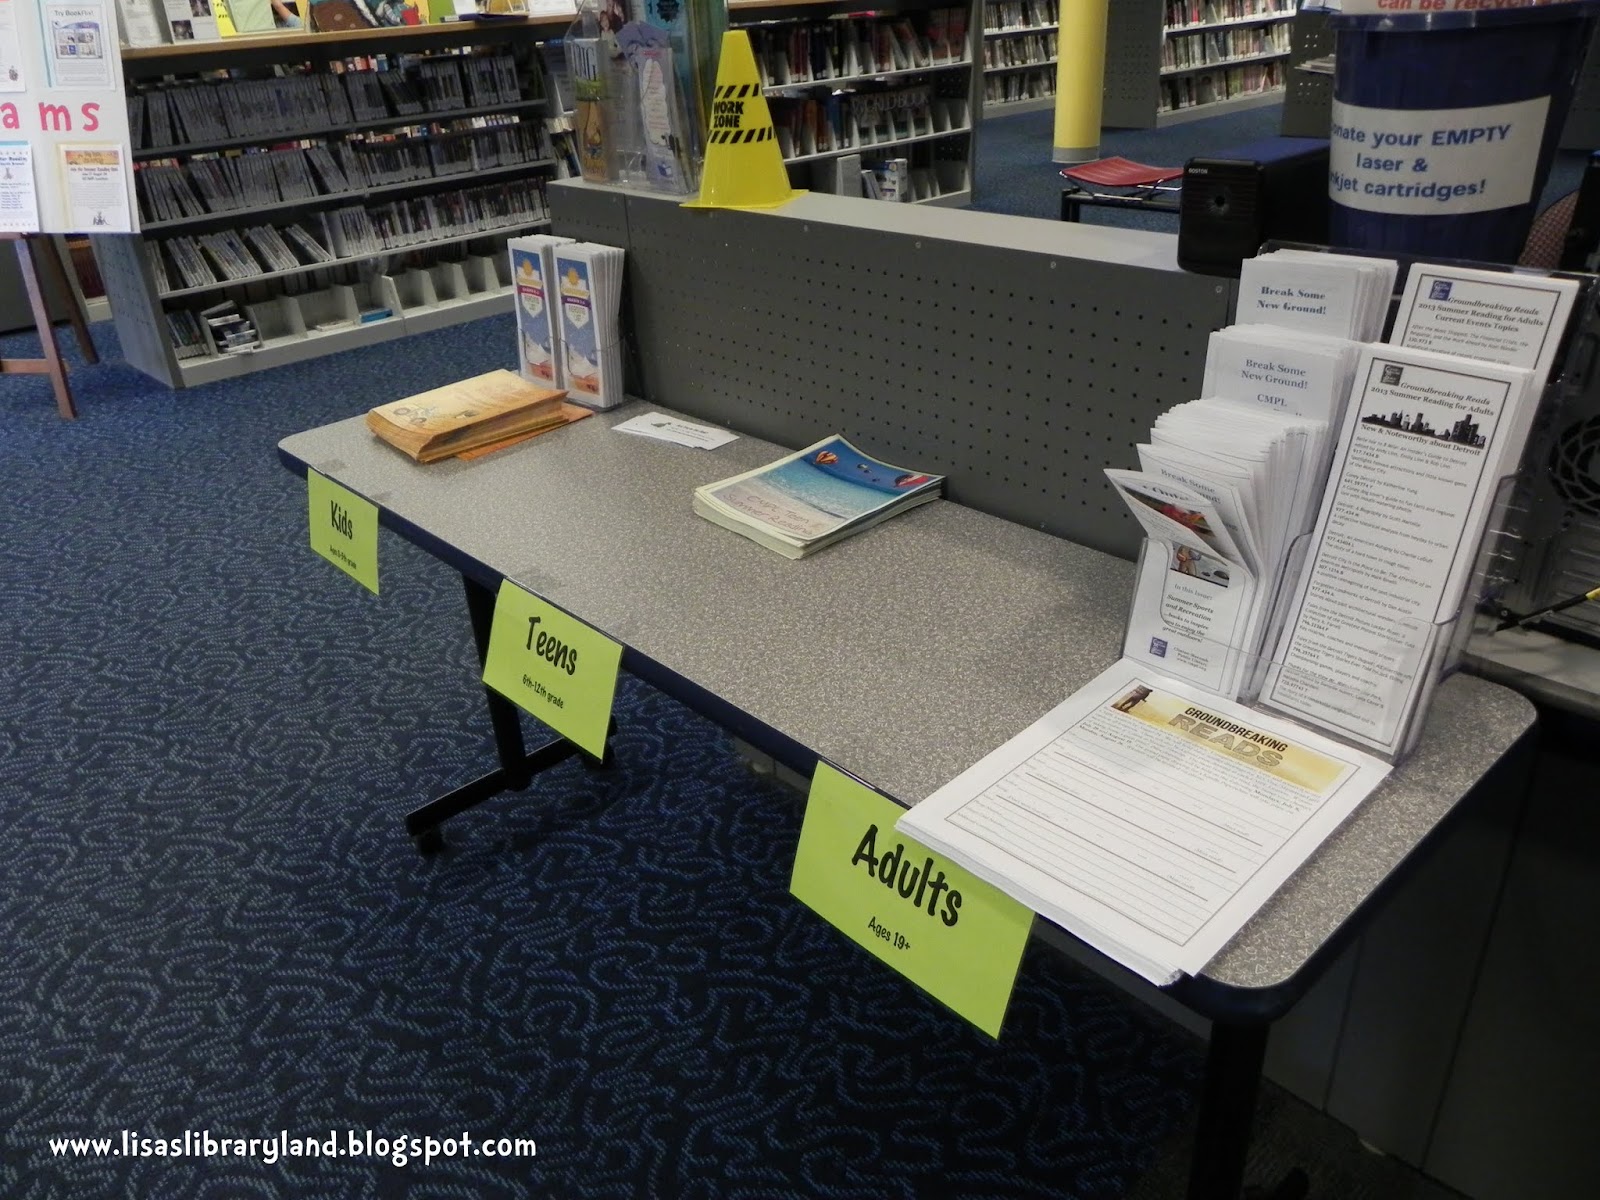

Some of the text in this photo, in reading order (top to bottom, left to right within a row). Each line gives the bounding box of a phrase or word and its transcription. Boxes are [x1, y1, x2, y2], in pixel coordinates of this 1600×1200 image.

[713, 101, 744, 114] WORK
[713, 115, 740, 128] ZONE
[1332, 124, 1512, 148] onate your EMPTY
[1356, 153, 1428, 172] laser &
[1364, 178, 1486, 202] cartridges!
[1261, 286, 1326, 300] Break Some
[1447, 297, 1512, 310] Groundbreaking
[1257, 300, 1327, 315] New Ground!
[1437, 305, 1468, 314] Summer
[1470, 310, 1502, 319] Reading
[1517, 317, 1543, 325] Adults
[1435, 314, 1464, 322] Current
[1493, 323, 1519, 332] Topics
[1246, 359, 1306, 376] Break Some
[1241, 370, 1308, 389] New Ground!
[1257, 394, 1288, 406] CMPL
[1389, 390, 1421, 400] Summer
[1422, 397, 1453, 408] Reading
[1469, 406, 1494, 415] Adults
[1400, 382, 1490, 404] Groundbreaking Reads
[1386, 430, 1426, 444] Noteworthy
[1429, 440, 1450, 448] about
[1453, 446, 1479, 455] Detroit
[1160, 469, 1188, 484] Break
[1189, 480, 1215, 493] Some
[331, 500, 353, 540] Kids
[1167, 594, 1213, 613] Summer Sports
[1178, 606, 1211, 620] Recreation
[526, 616, 577, 675] Teens
[522, 674, 564, 709] 6th-12th grade
[1184, 707, 1288, 752] GROUNDBREAKING
[1168, 714, 1283, 767] READS
[852, 824, 962, 926] Adults
[868, 916, 911, 950] Ages 19+
